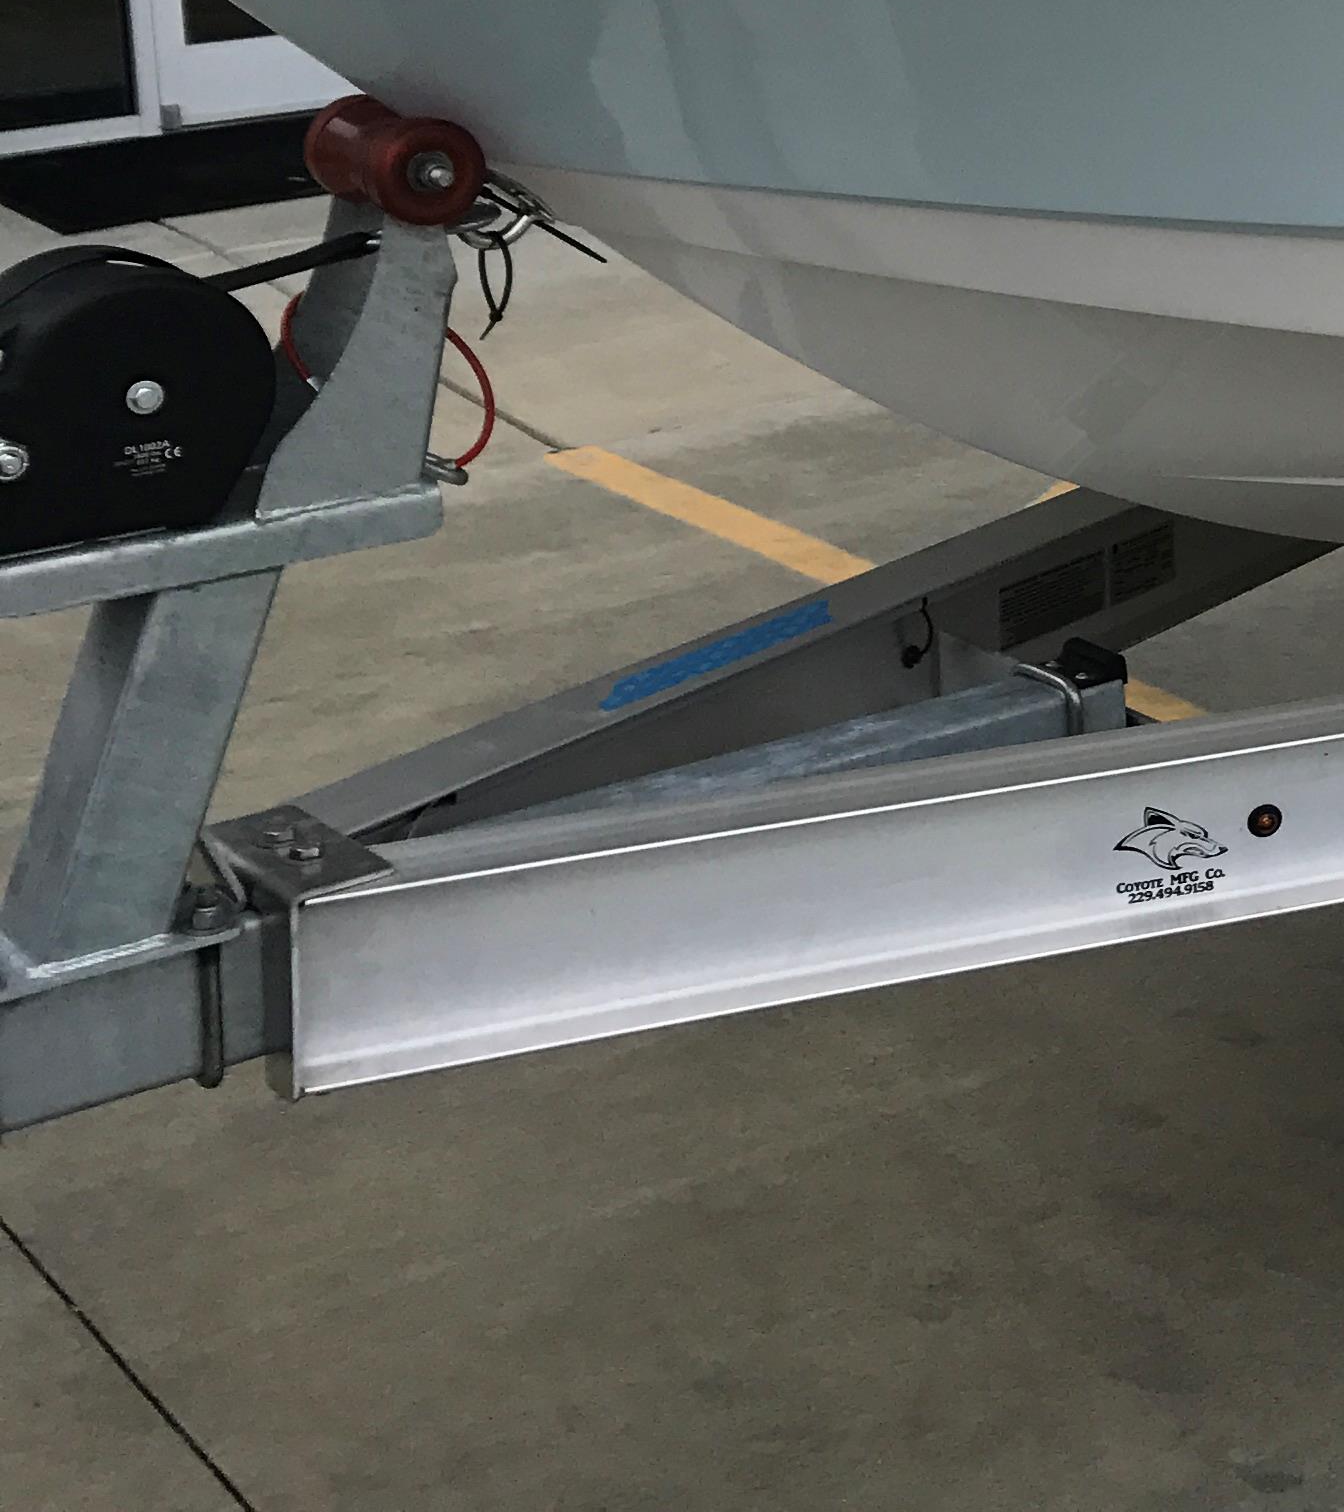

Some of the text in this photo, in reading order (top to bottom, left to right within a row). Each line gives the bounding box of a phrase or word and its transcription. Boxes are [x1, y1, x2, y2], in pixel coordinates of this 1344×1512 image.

[1116, 878, 1164, 894] COYOTE
[1170, 871, 1199, 886] MFG
[1128, 881, 1215, 904] 229.494.9158
